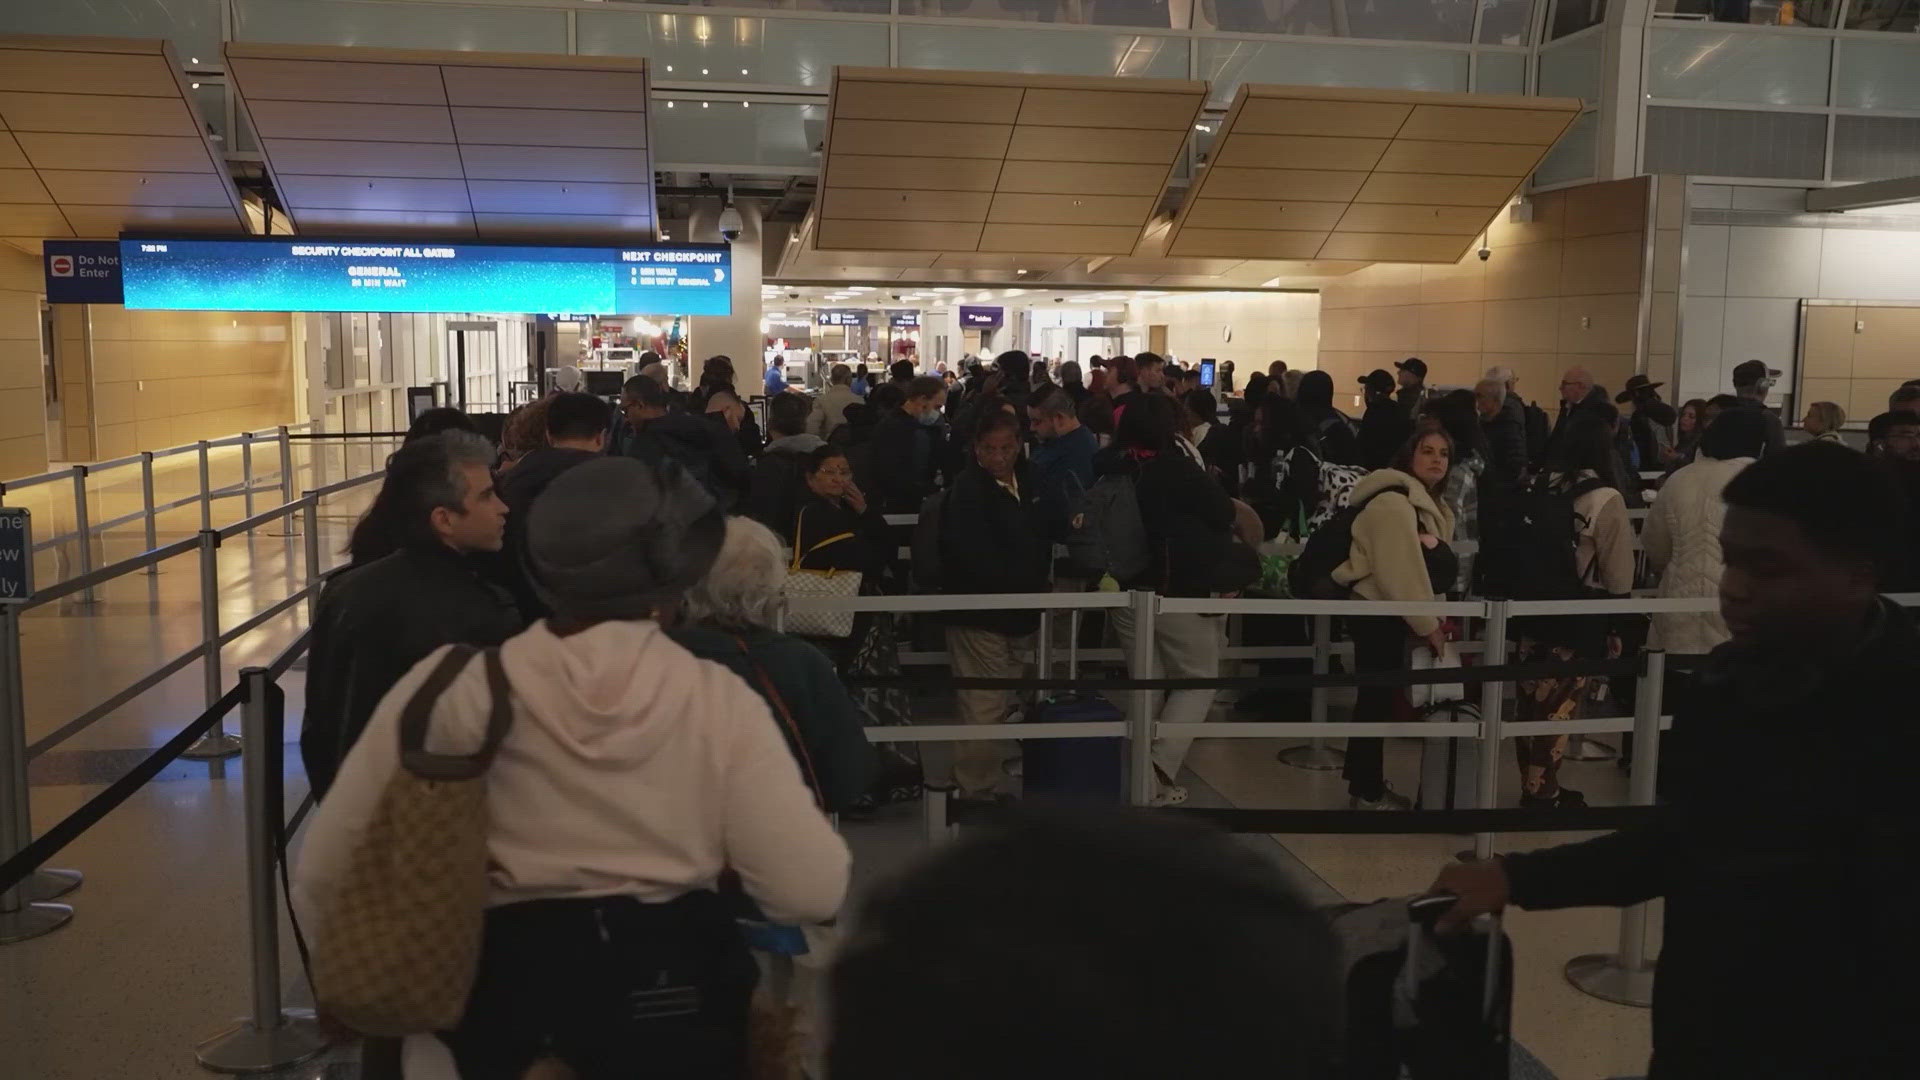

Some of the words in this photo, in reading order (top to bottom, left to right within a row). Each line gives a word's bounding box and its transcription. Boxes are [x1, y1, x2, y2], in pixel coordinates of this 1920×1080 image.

[292, 246, 340, 256] SECURITY
[341, 246, 403, 257] CHECKPOINT
[403, 248, 422, 258] ALL
[423, 248, 455, 258] GATES
[622, 251, 651, 262] NEXT
[653, 252, 722, 263] CHECKPOINT
[79, 256, 95, 265] Do
[98, 256, 119, 265] Not
[80, 268, 110, 278] Enter
[348, 266, 401, 277] GENERAL
[363, 279, 380, 287] MIN
[384, 279, 407, 288] WAIT
[0, 549, 19, 561] w
